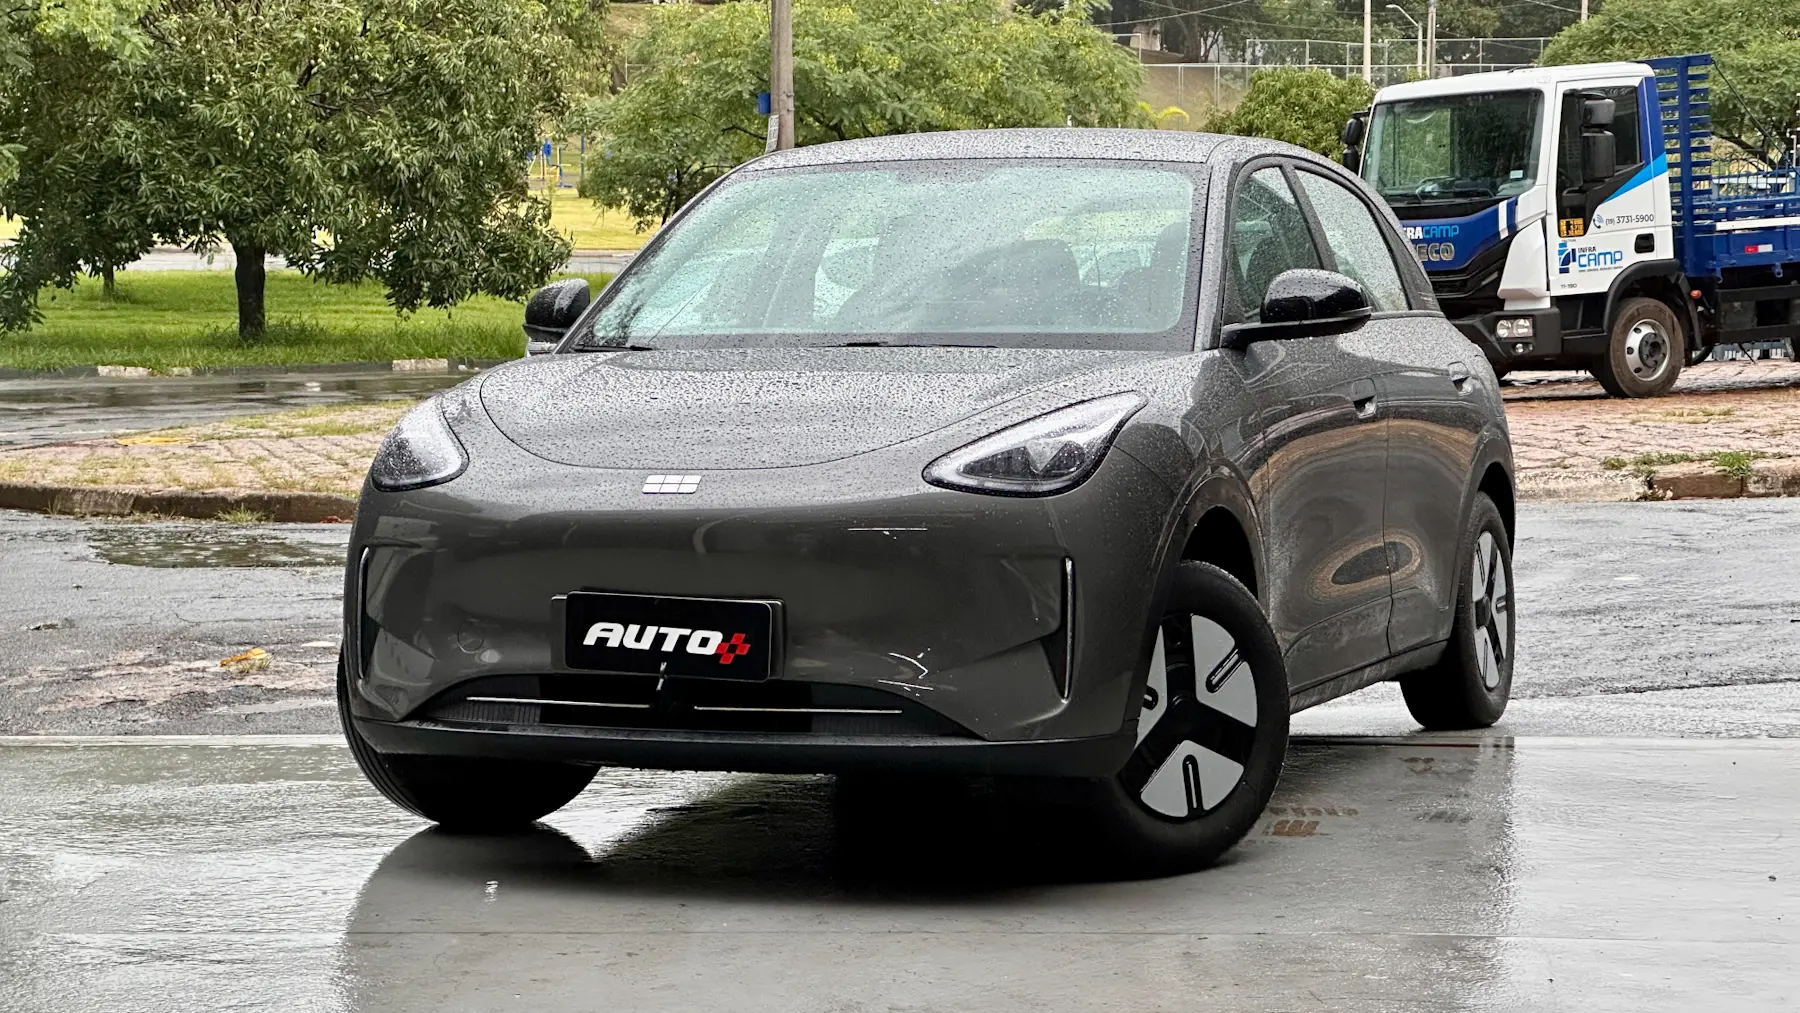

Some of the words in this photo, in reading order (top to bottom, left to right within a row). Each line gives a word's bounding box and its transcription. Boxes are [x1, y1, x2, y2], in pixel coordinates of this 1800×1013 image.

[1616, 214, 1655, 224] 3731-5900
[1403, 225, 1459, 240] RACAMP
[1413, 242, 1455, 262] ECO
[1578, 250, 1623, 268] CAMP
